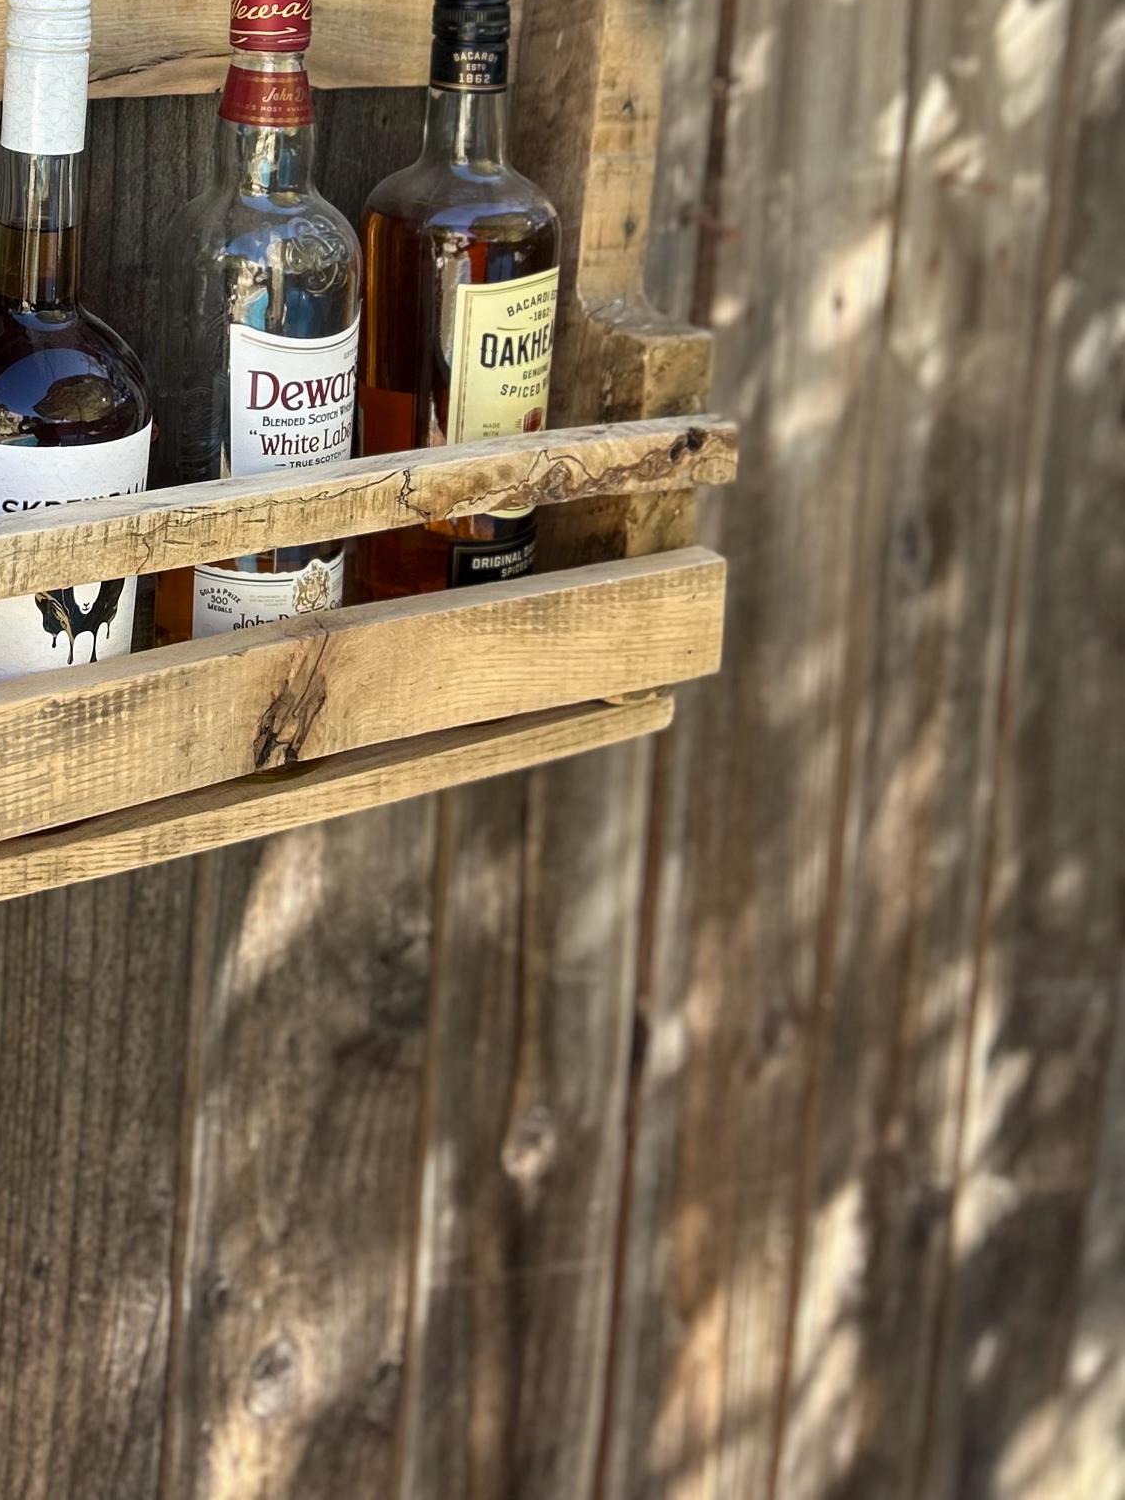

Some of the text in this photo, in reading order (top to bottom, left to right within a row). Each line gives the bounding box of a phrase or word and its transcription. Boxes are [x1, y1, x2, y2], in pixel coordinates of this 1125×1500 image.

[459, 73, 491, 84] 1862
[262, 88, 293, 103] John
[500, 382, 541, 399] SPICED
[289, 459, 313, 469] TRUE
[472, 550, 522, 570] ORIGINAL
[210, 595, 229, 606] 500
